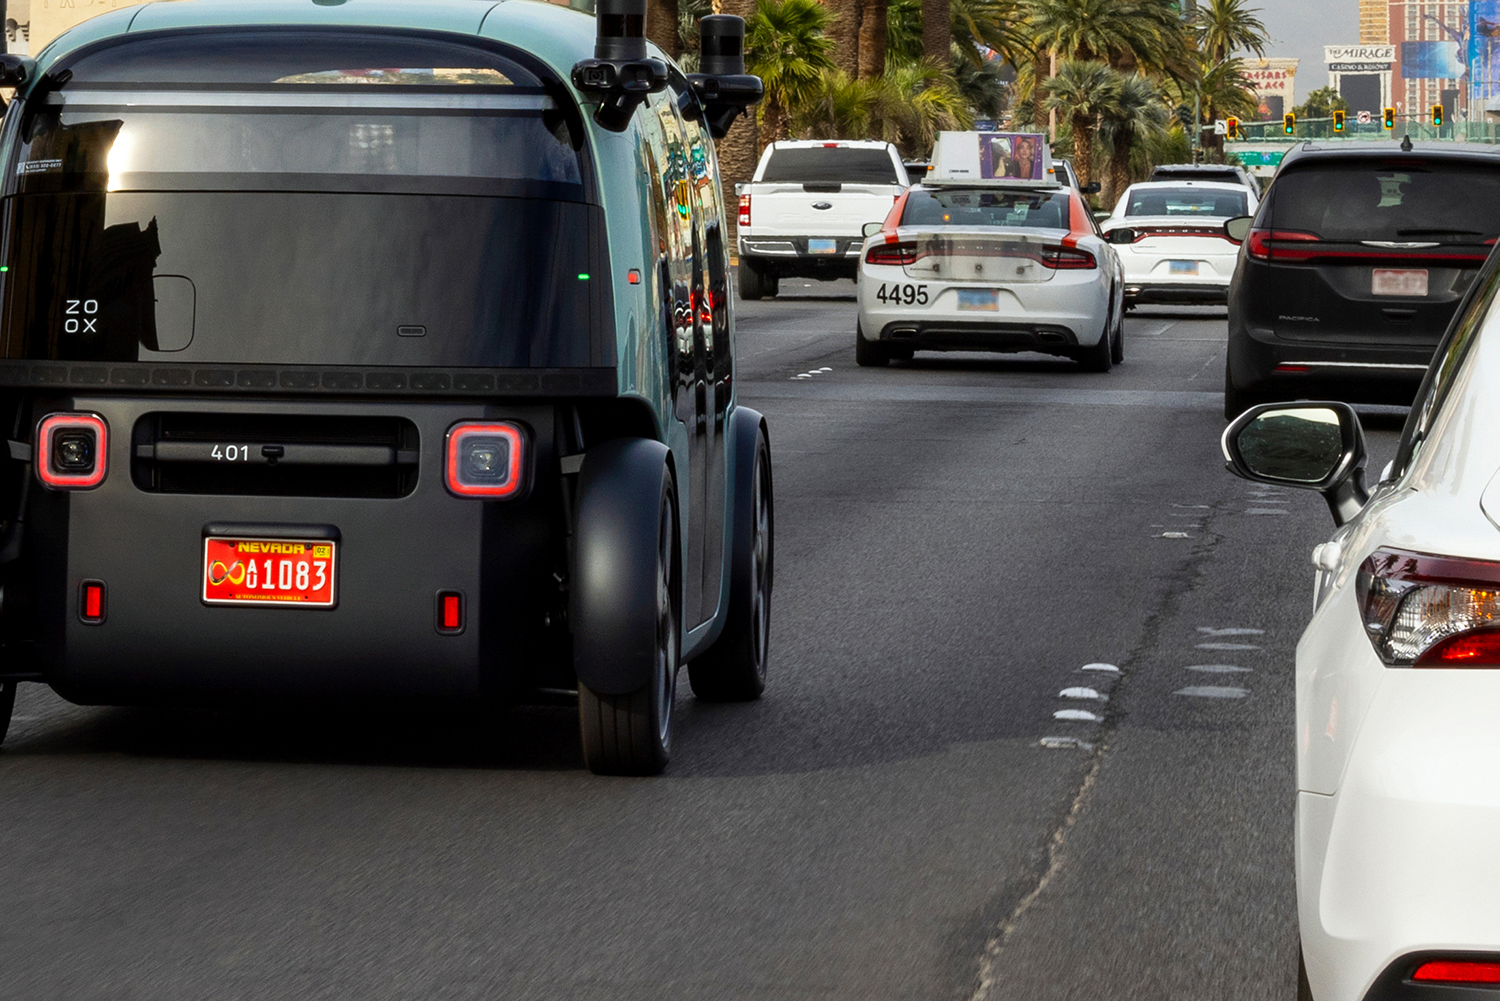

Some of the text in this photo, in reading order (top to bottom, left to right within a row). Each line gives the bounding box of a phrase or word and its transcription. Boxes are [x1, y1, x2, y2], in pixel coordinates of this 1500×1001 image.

[1334, 47, 1393, 60] MIRAGE
[1331, 62, 1357, 71] CASINO
[1363, 63, 1389, 71] RESORT
[876, 283, 929, 306] 4495
[1278, 315, 1320, 323] PACIFICA
[210, 444, 249, 461] 401
[237, 541, 305, 555] NEVADA
